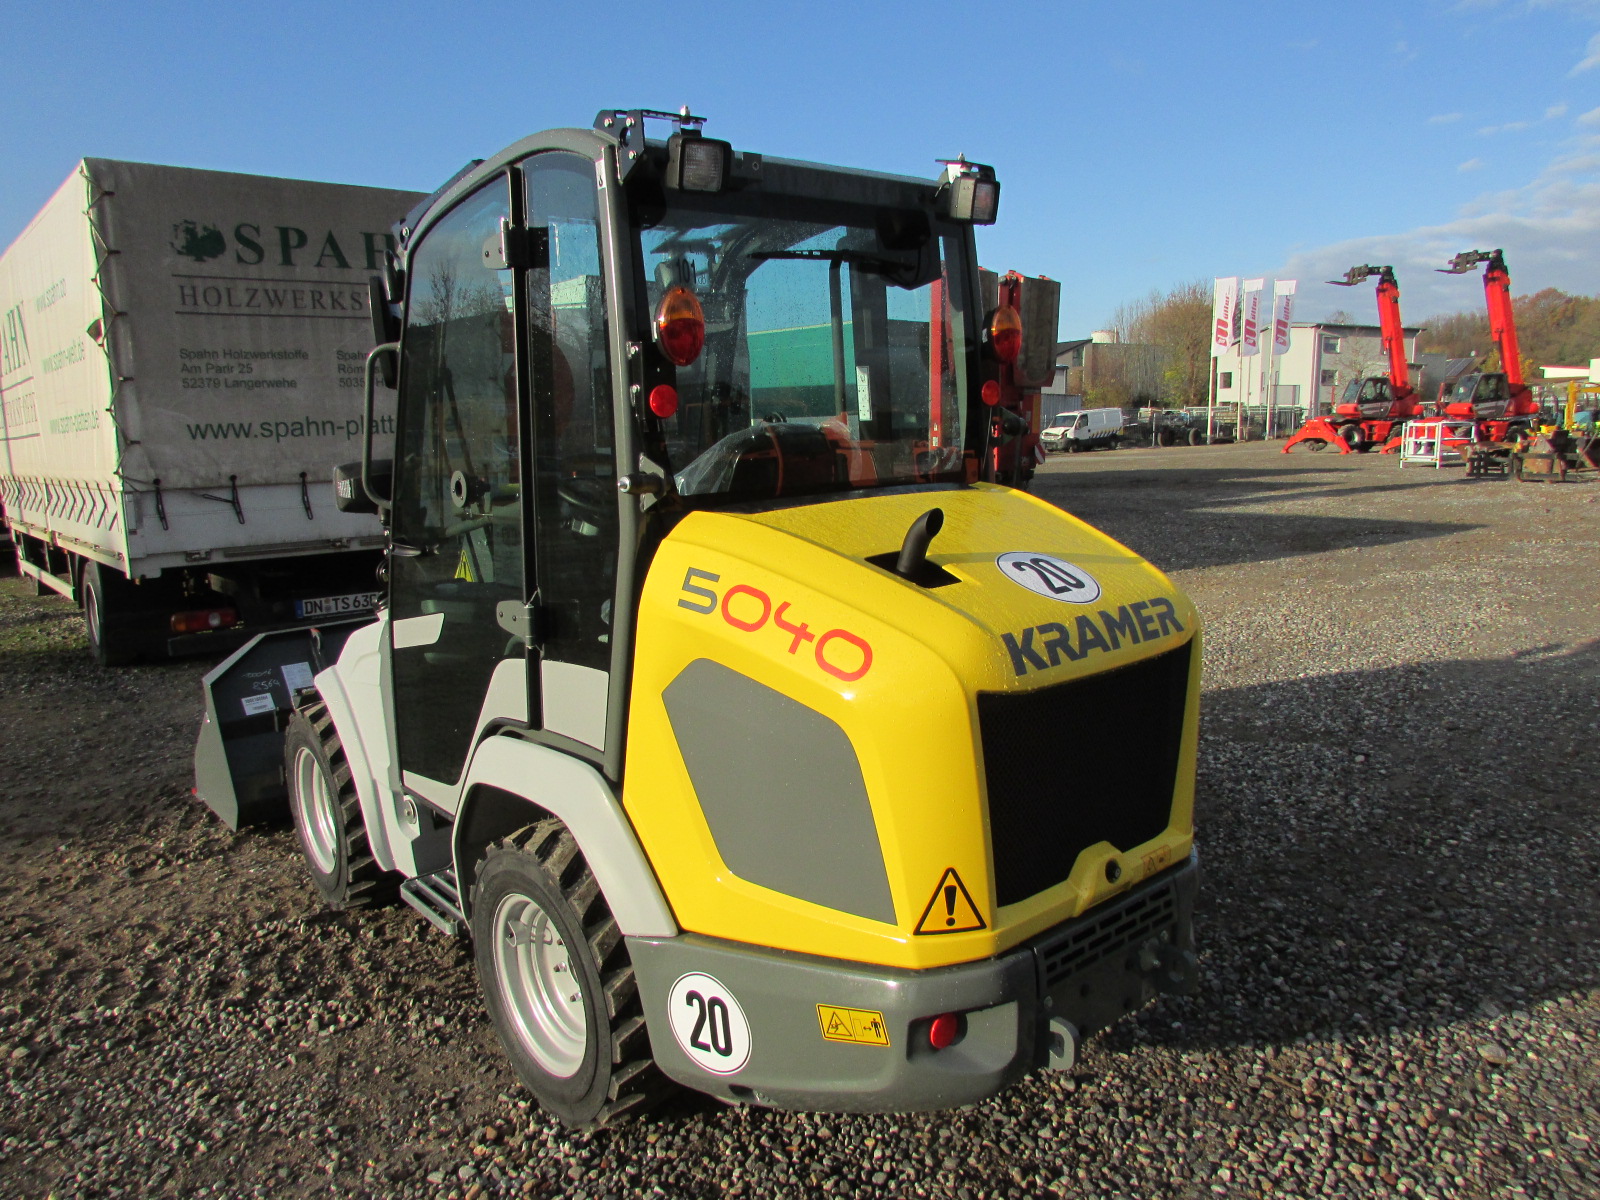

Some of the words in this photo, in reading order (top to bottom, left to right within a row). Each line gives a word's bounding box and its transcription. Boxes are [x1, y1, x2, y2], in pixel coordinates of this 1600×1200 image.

[676, 258, 696, 284] 101
[179, 284, 368, 312] HOLZWERKS
[179, 348, 219, 362] Spahn
[222, 349, 309, 361] Holzwerkstoffe
[180, 363, 202, 374] Am
[238, 363, 253, 374] 25
[182, 377, 221, 389] 52379
[224, 377, 298, 391] Langerwehe
[1013, 557, 1085, 594] 20
[304, 599, 323, 615] DN
[331, 596, 350, 611] TS
[677, 567, 873, 682] 5040
[1000, 597, 1184, 677] KRAMER
[686, 989, 733, 1058] 20
